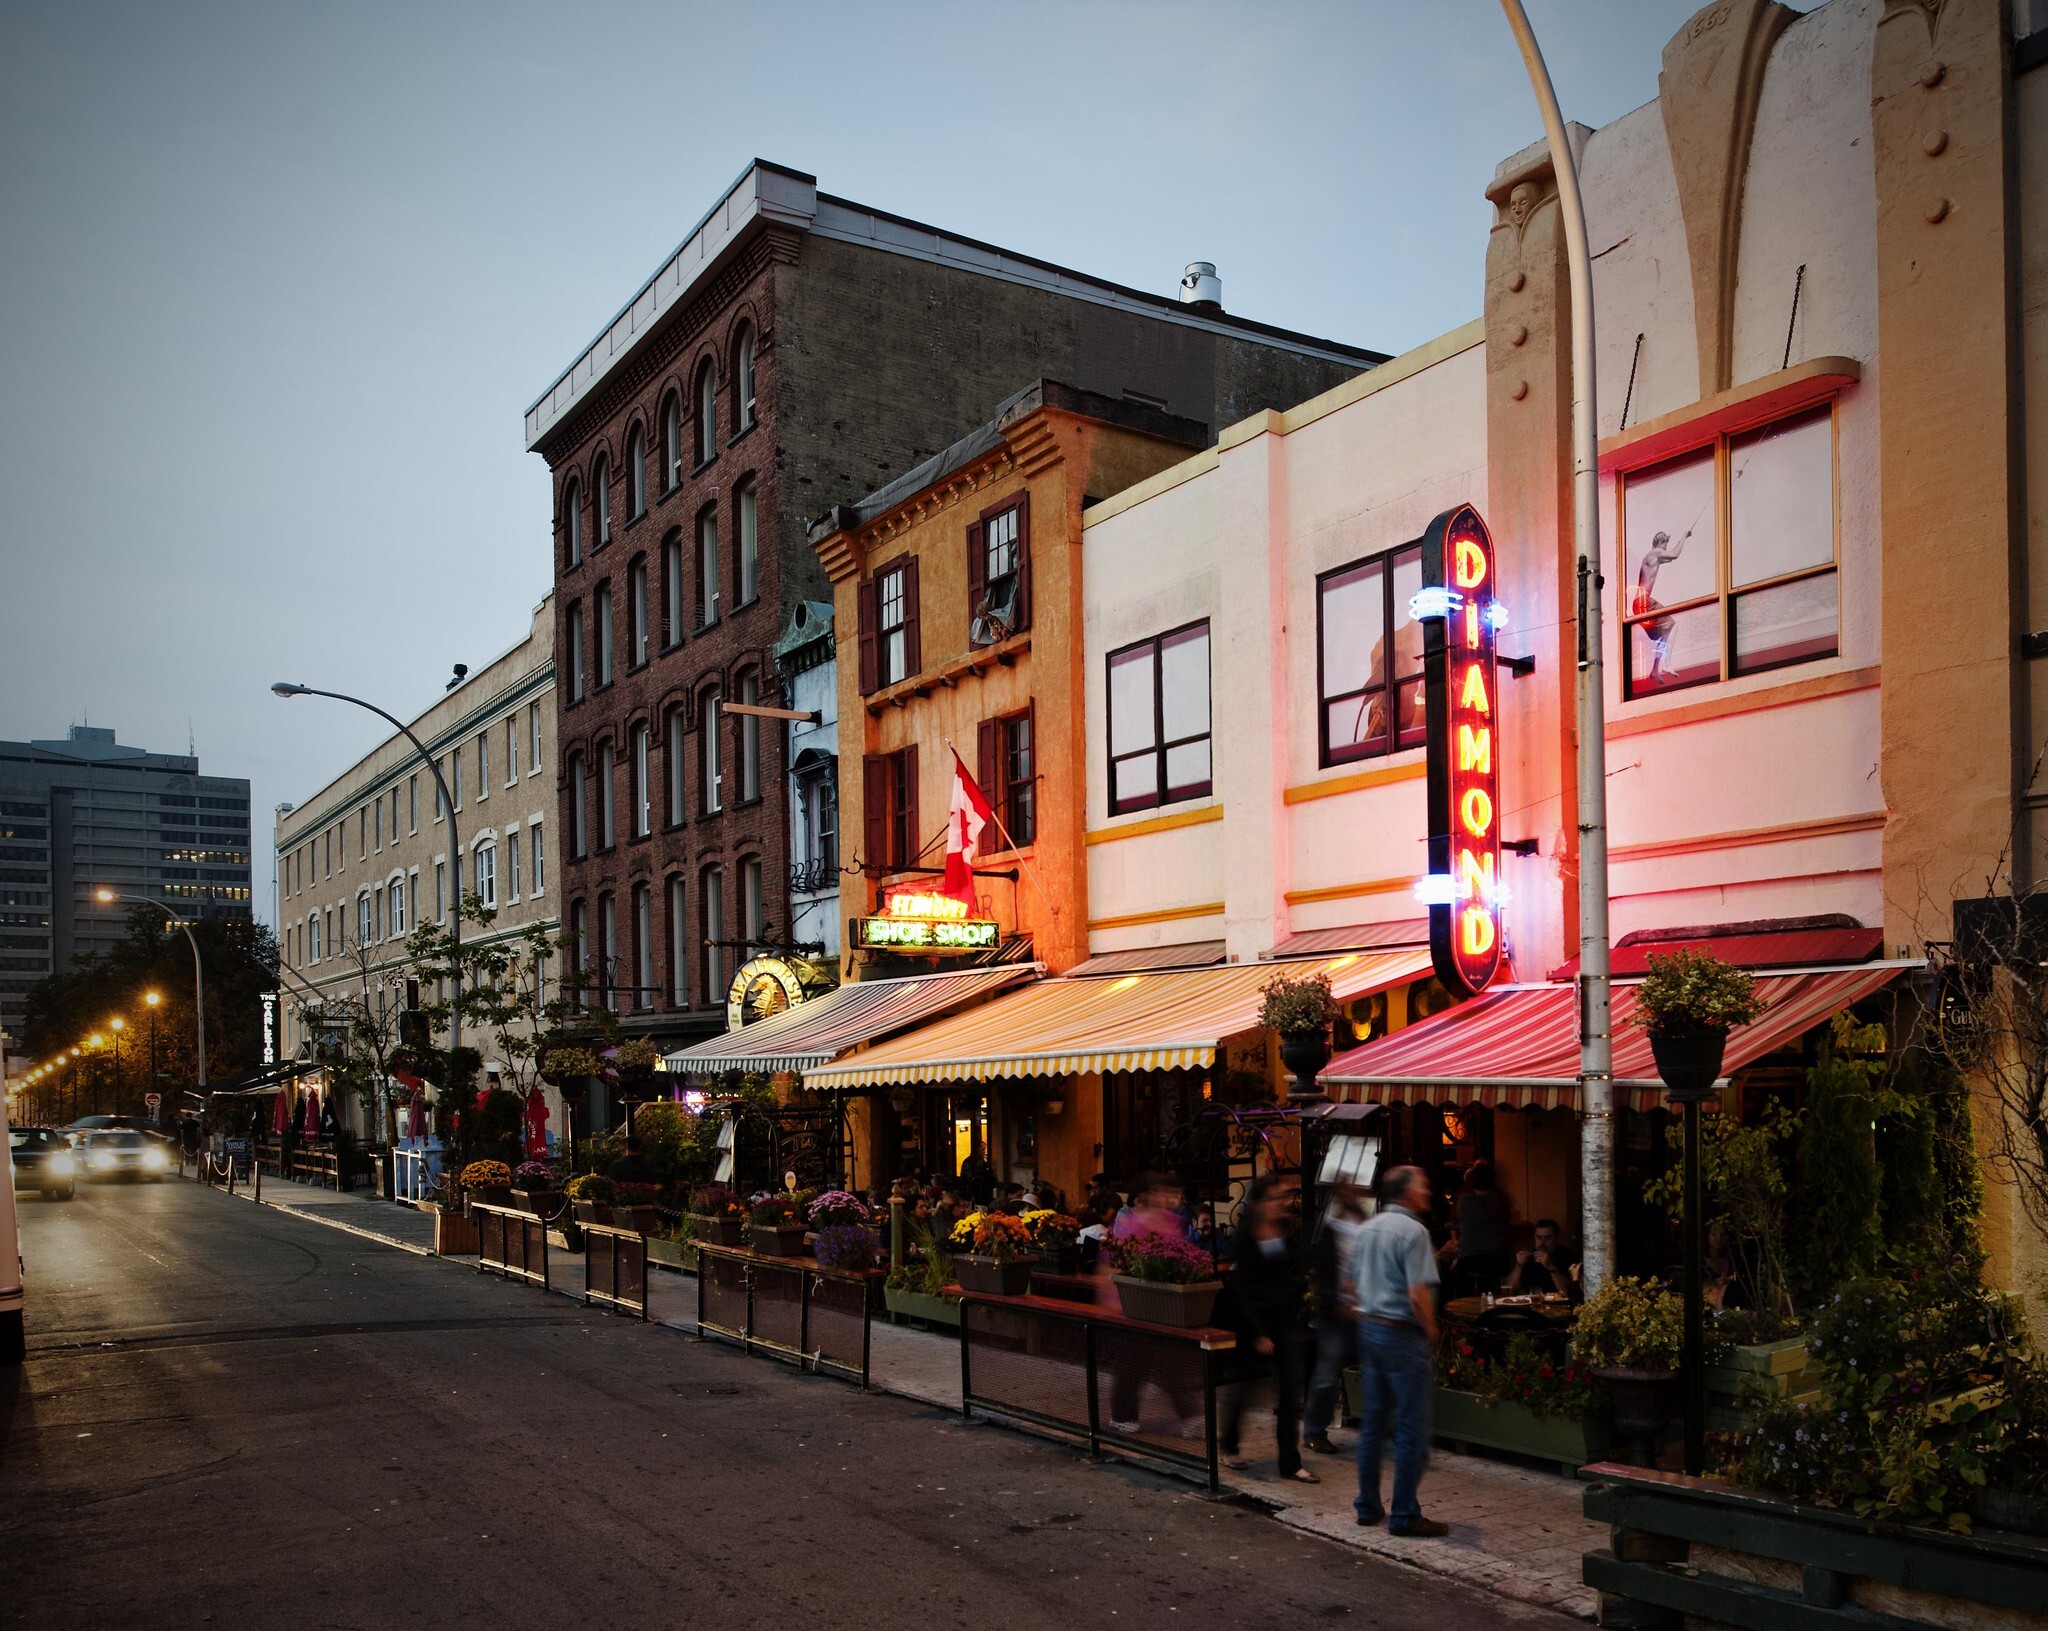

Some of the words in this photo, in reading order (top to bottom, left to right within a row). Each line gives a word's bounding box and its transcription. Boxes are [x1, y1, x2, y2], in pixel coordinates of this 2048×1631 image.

[1455, 539, 1496, 957] DIAMOND
[868, 919, 932, 942] SHOE
[935, 922, 996, 944] SHOP
[263, 1001, 274, 1063] CARLETON
